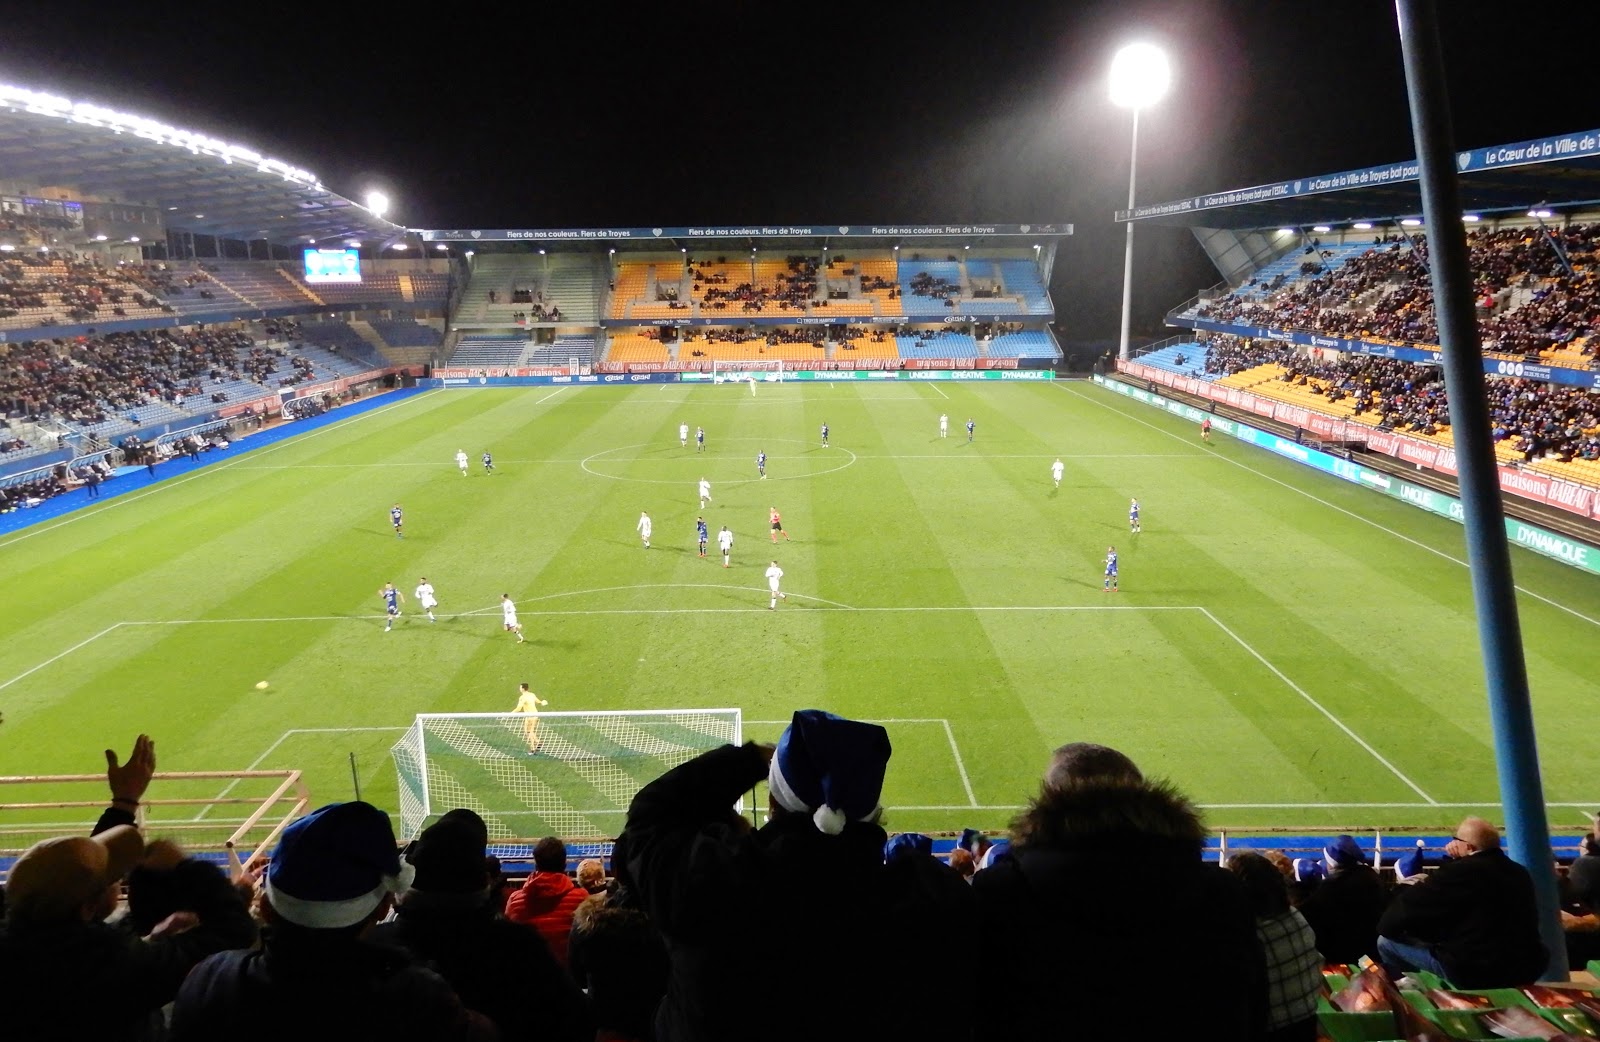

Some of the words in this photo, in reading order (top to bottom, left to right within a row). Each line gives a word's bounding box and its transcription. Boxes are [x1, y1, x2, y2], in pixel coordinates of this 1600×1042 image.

[1486, 152, 1496, 164] Le
[1498, 149, 1525, 164] Cœur
[1526, 144, 1540, 158] de
[1542, 142, 1552, 156] la
[1555, 138, 1577, 154] Ville
[1579, 136, 1595, 150] de
[1308, 181, 1315, 190] Le
[1316, 179, 1331, 190] Cœur
[1332, 177, 1339, 187] de
[1340, 176, 1346, 186] la
[1347, 173, 1360, 185] Ville
[1360, 172, 1369, 183] de
[1370, 170, 1389, 182] Troyes
[1390, 166, 1402, 179] bat
[1403, 166, 1419, 179] pour
[1242, 192, 1253, 202] Troyes
[1262, 189, 1271, 199] pour
[581, 230, 596, 238] Fiers
[608, 230, 631, 238] Troyes
[688, 228, 704, 236] Fiers
[762, 227, 778, 235] Fiers
[790, 227, 812, 236] Troyes
[945, 226, 960, 234] Fiers
[973, 226, 995, 235] Troyes
[629, 362, 661, 370] maisons
[822, 360, 855, 369] maisons
[916, 358, 948, 368] maisons
[987, 358, 1018, 368] maisons
[434, 369, 467, 378] maisons
[1403, 442, 1436, 463] maisons
[1502, 471, 1548, 498] maisons
[1517, 526, 1588, 566] DYNAMIQUE
